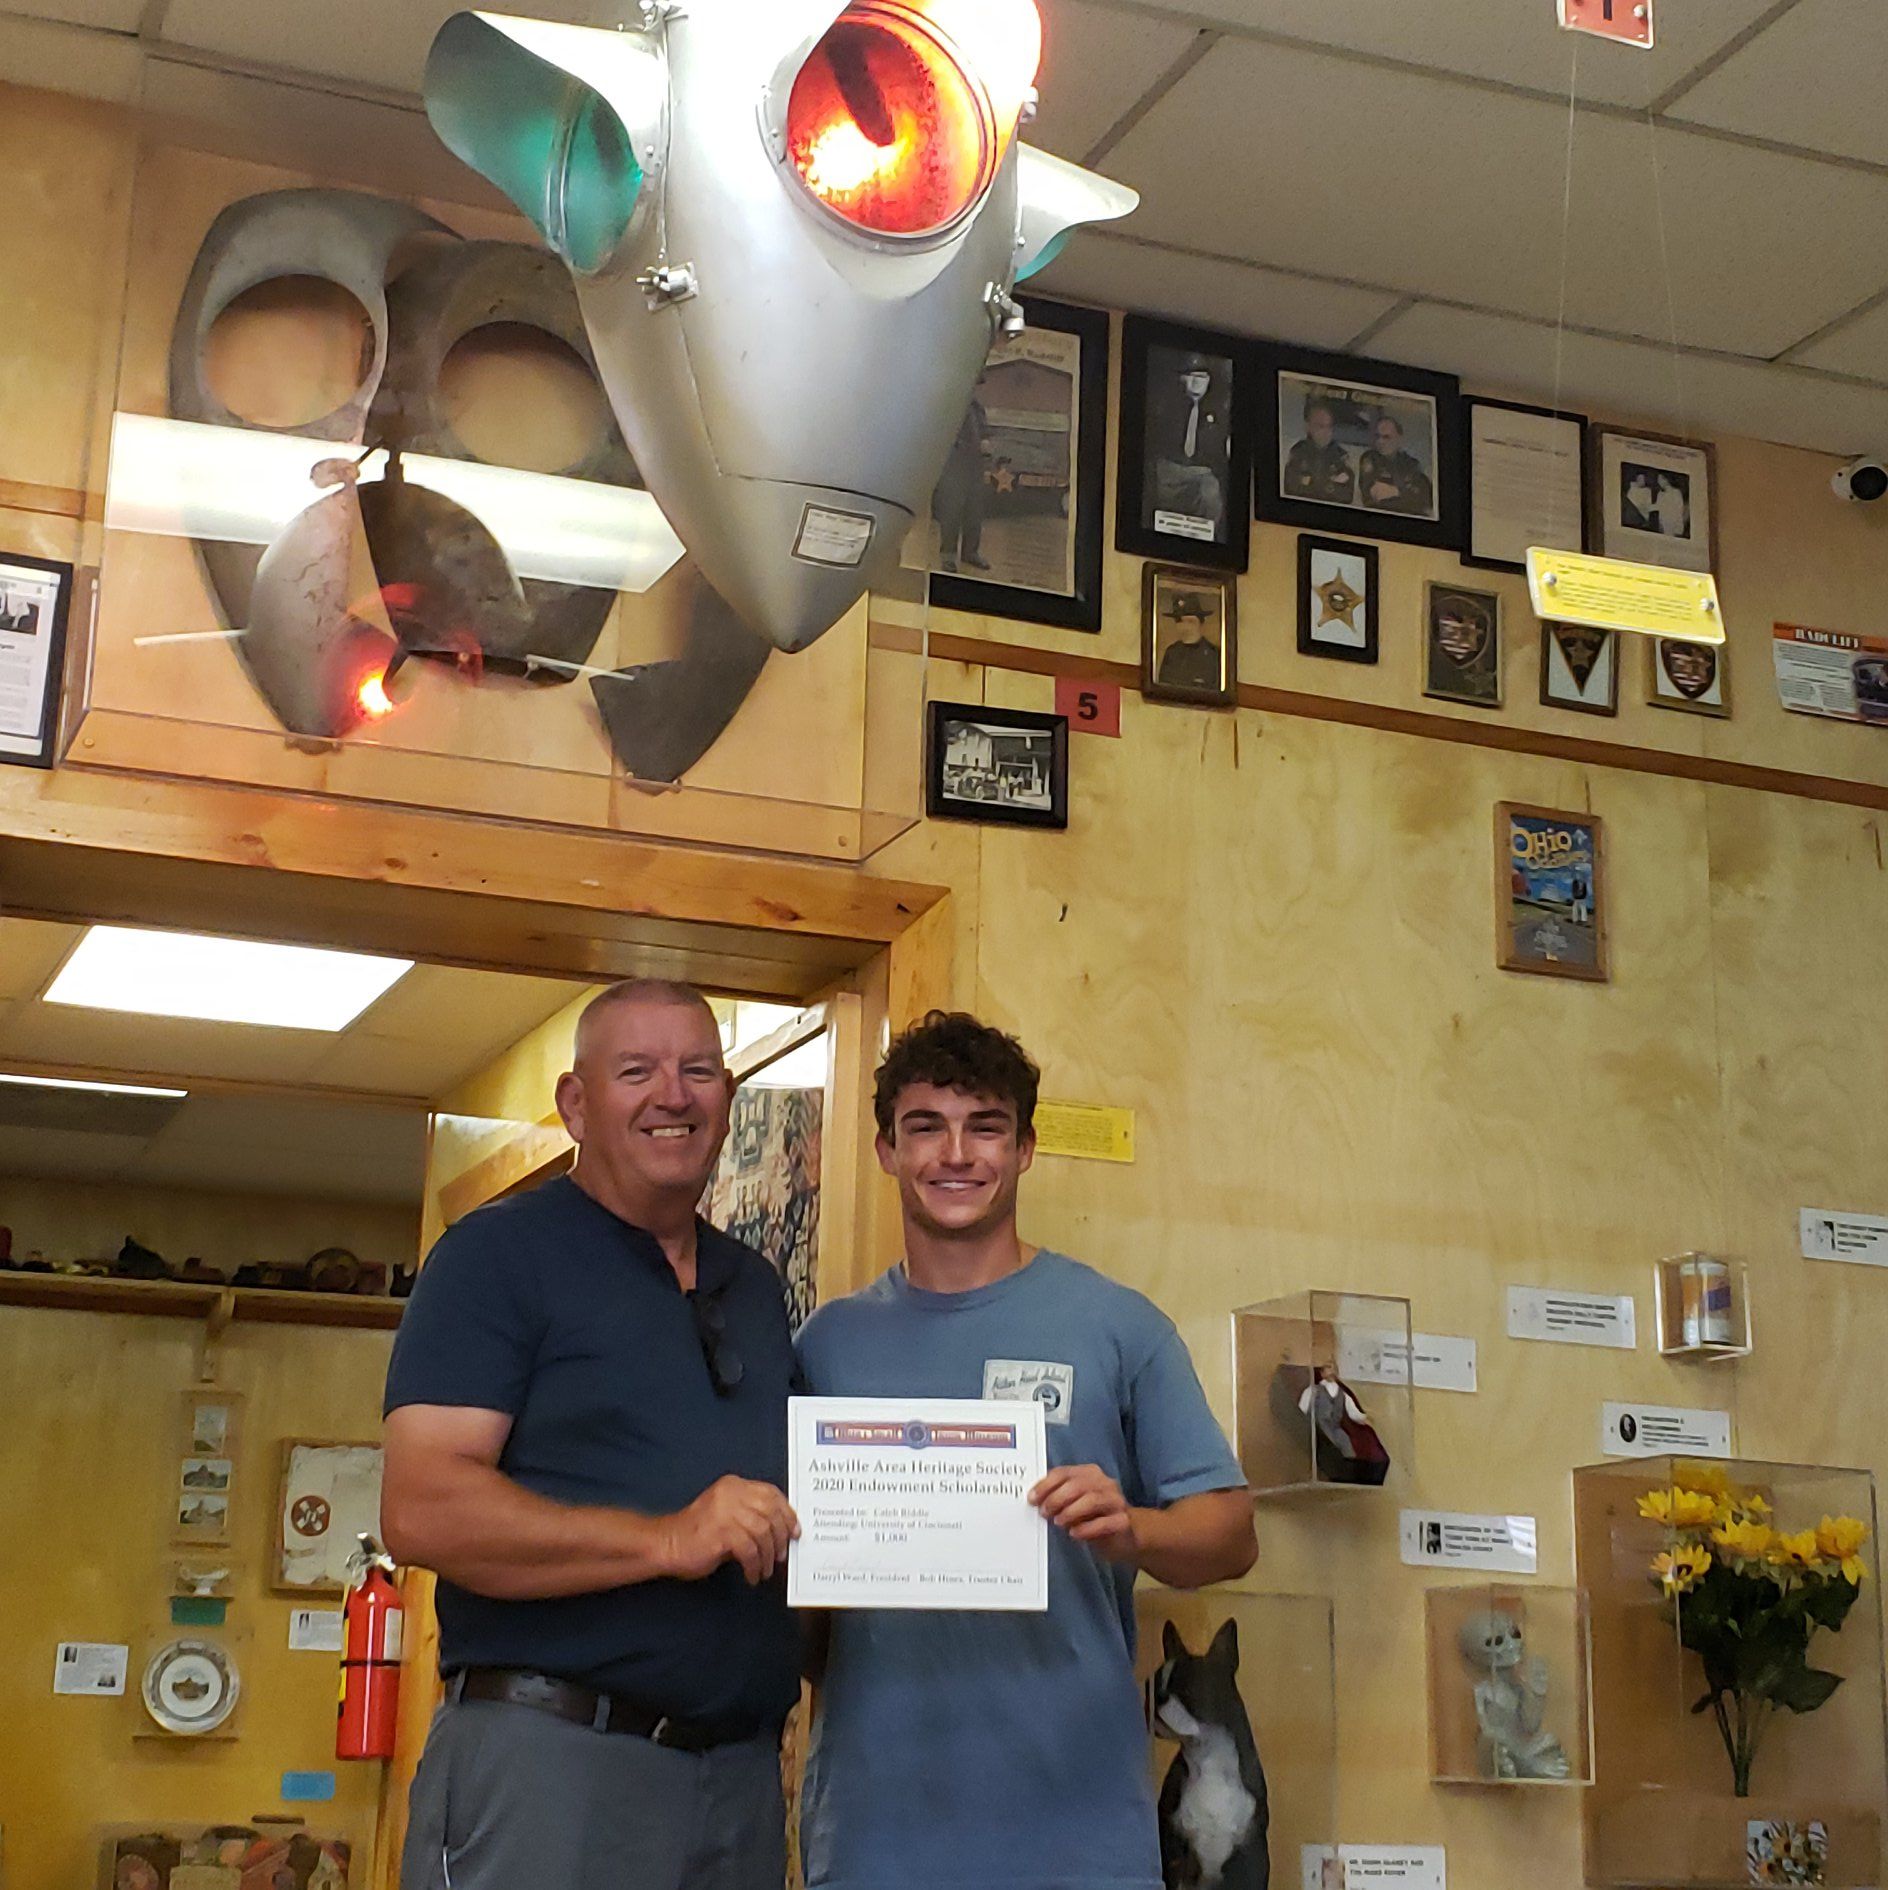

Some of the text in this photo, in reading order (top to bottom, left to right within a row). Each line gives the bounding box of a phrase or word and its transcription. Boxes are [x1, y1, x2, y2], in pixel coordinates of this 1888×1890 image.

[1078, 692, 1098, 721] 5
[808, 1458, 1027, 1478] Ashville Area Heritage Society
[812, 1478, 1024, 1499] 2020 Endowment Scholarship
[812, 1508, 854, 1518] Presented
[860, 1520, 905, 1531] University
[907, 1520, 916, 1530] of
[917, 1521, 963, 1531] Cincinnati
